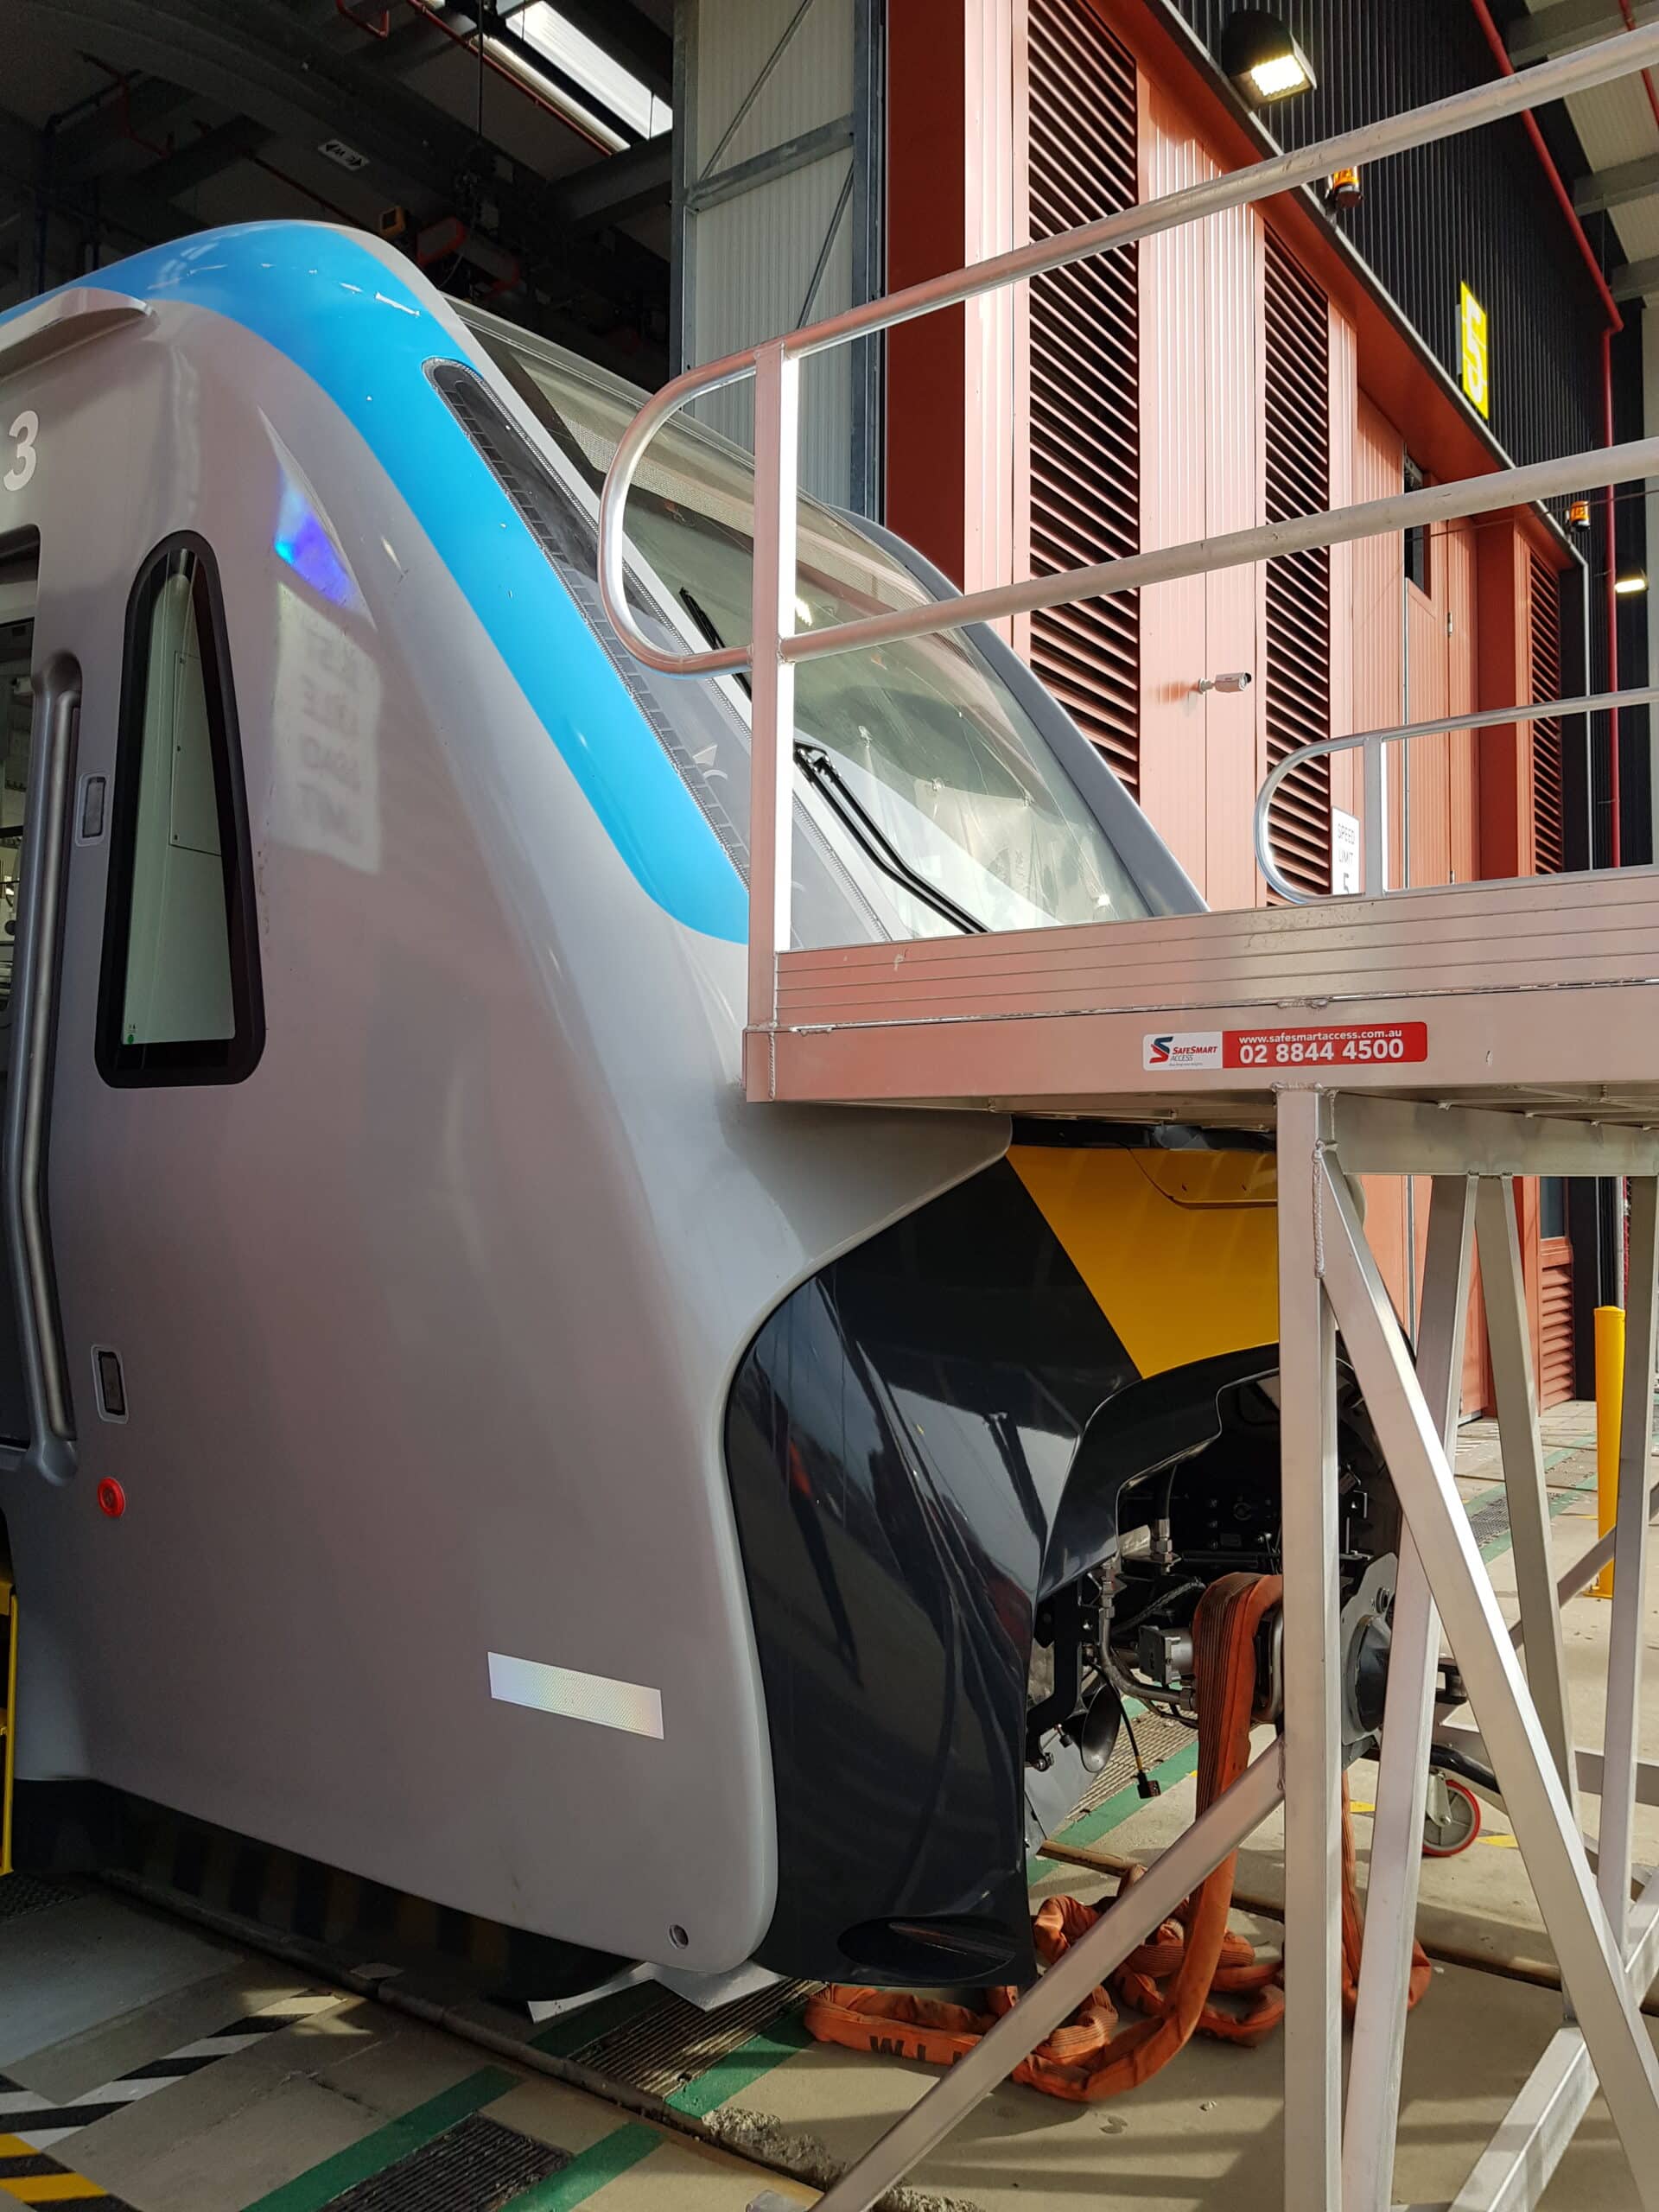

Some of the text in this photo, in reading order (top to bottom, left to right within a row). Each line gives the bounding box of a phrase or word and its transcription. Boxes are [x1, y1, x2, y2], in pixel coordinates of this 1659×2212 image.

[1466, 294, 1484, 404] 5
[3, 410, 39, 492] 3
[1338, 823, 1356, 845] SPEED
[1339, 849, 1354, 866] LIMIT
[1239, 1029, 1402, 1045] www.safesmartaccess.com.au
[1172, 1046, 1218, 1055] SAFESMART
[1239, 1039, 1405, 1065] 02 8844 4500
